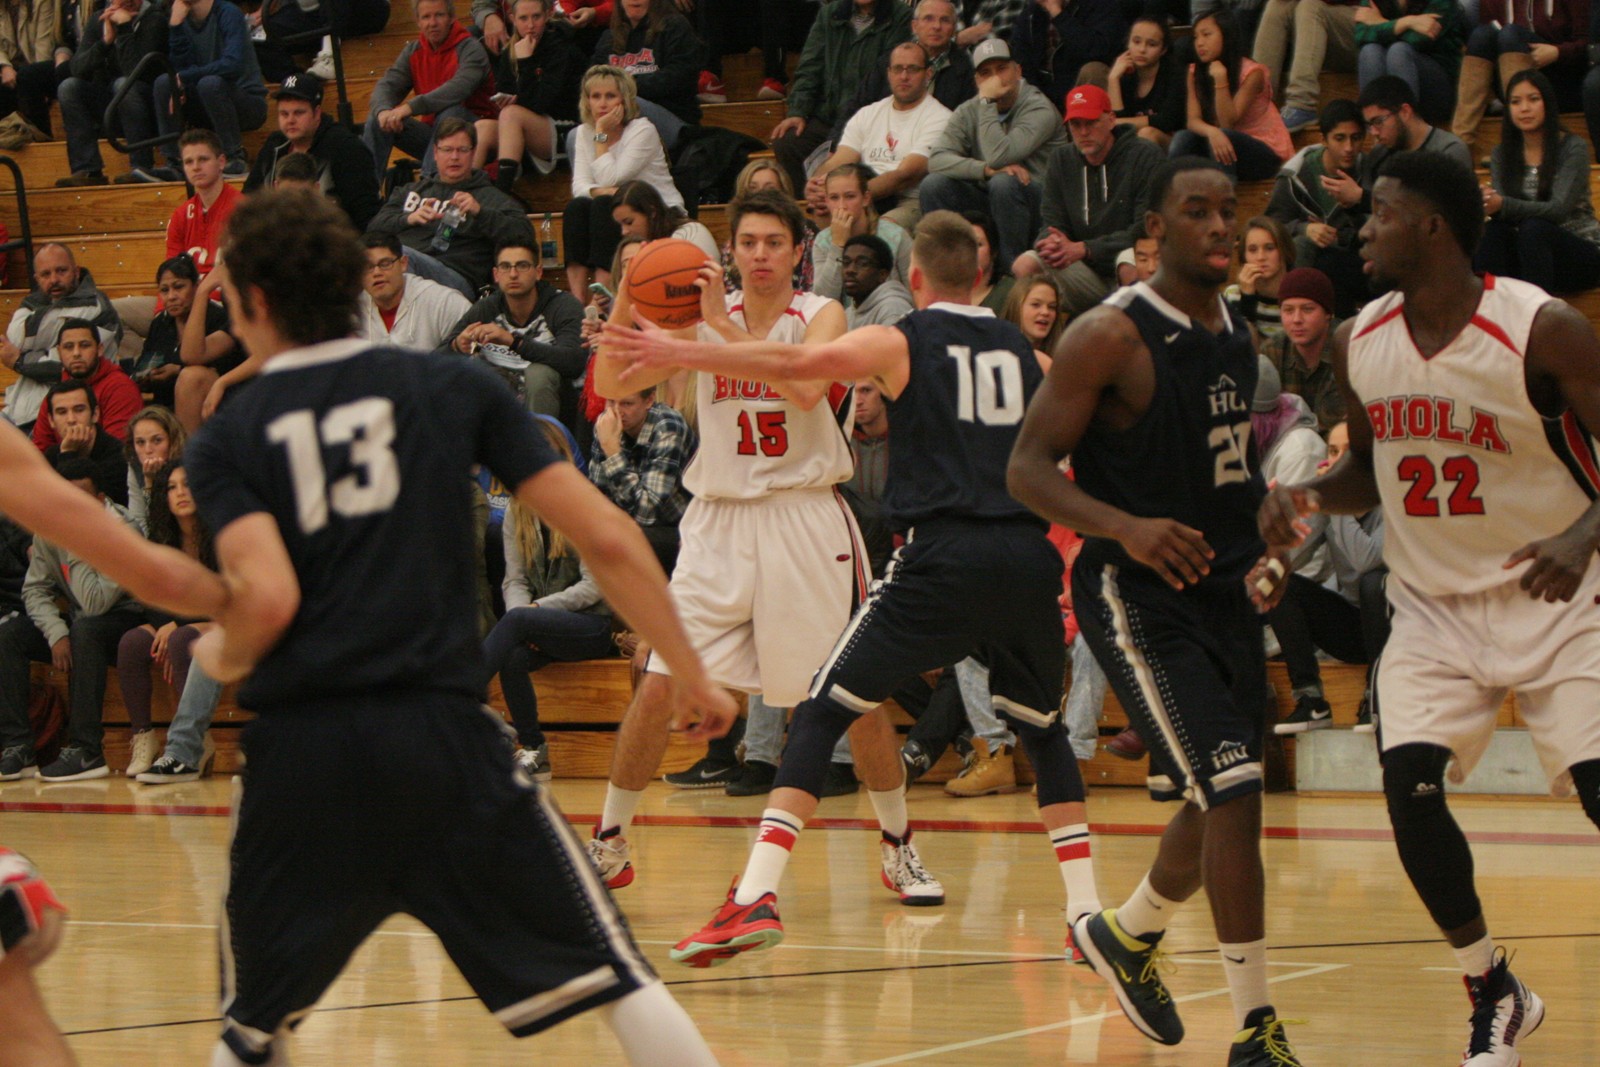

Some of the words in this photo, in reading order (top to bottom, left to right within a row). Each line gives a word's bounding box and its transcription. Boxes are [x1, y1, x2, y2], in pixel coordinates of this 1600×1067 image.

[712, 373, 787, 404] BIOL
[946, 344, 1024, 426] 10
[737, 409, 788, 457] 15
[1364, 394, 1512, 455] BIOLA
[265, 395, 401, 535] 13
[1397, 454, 1486, 517] 22
